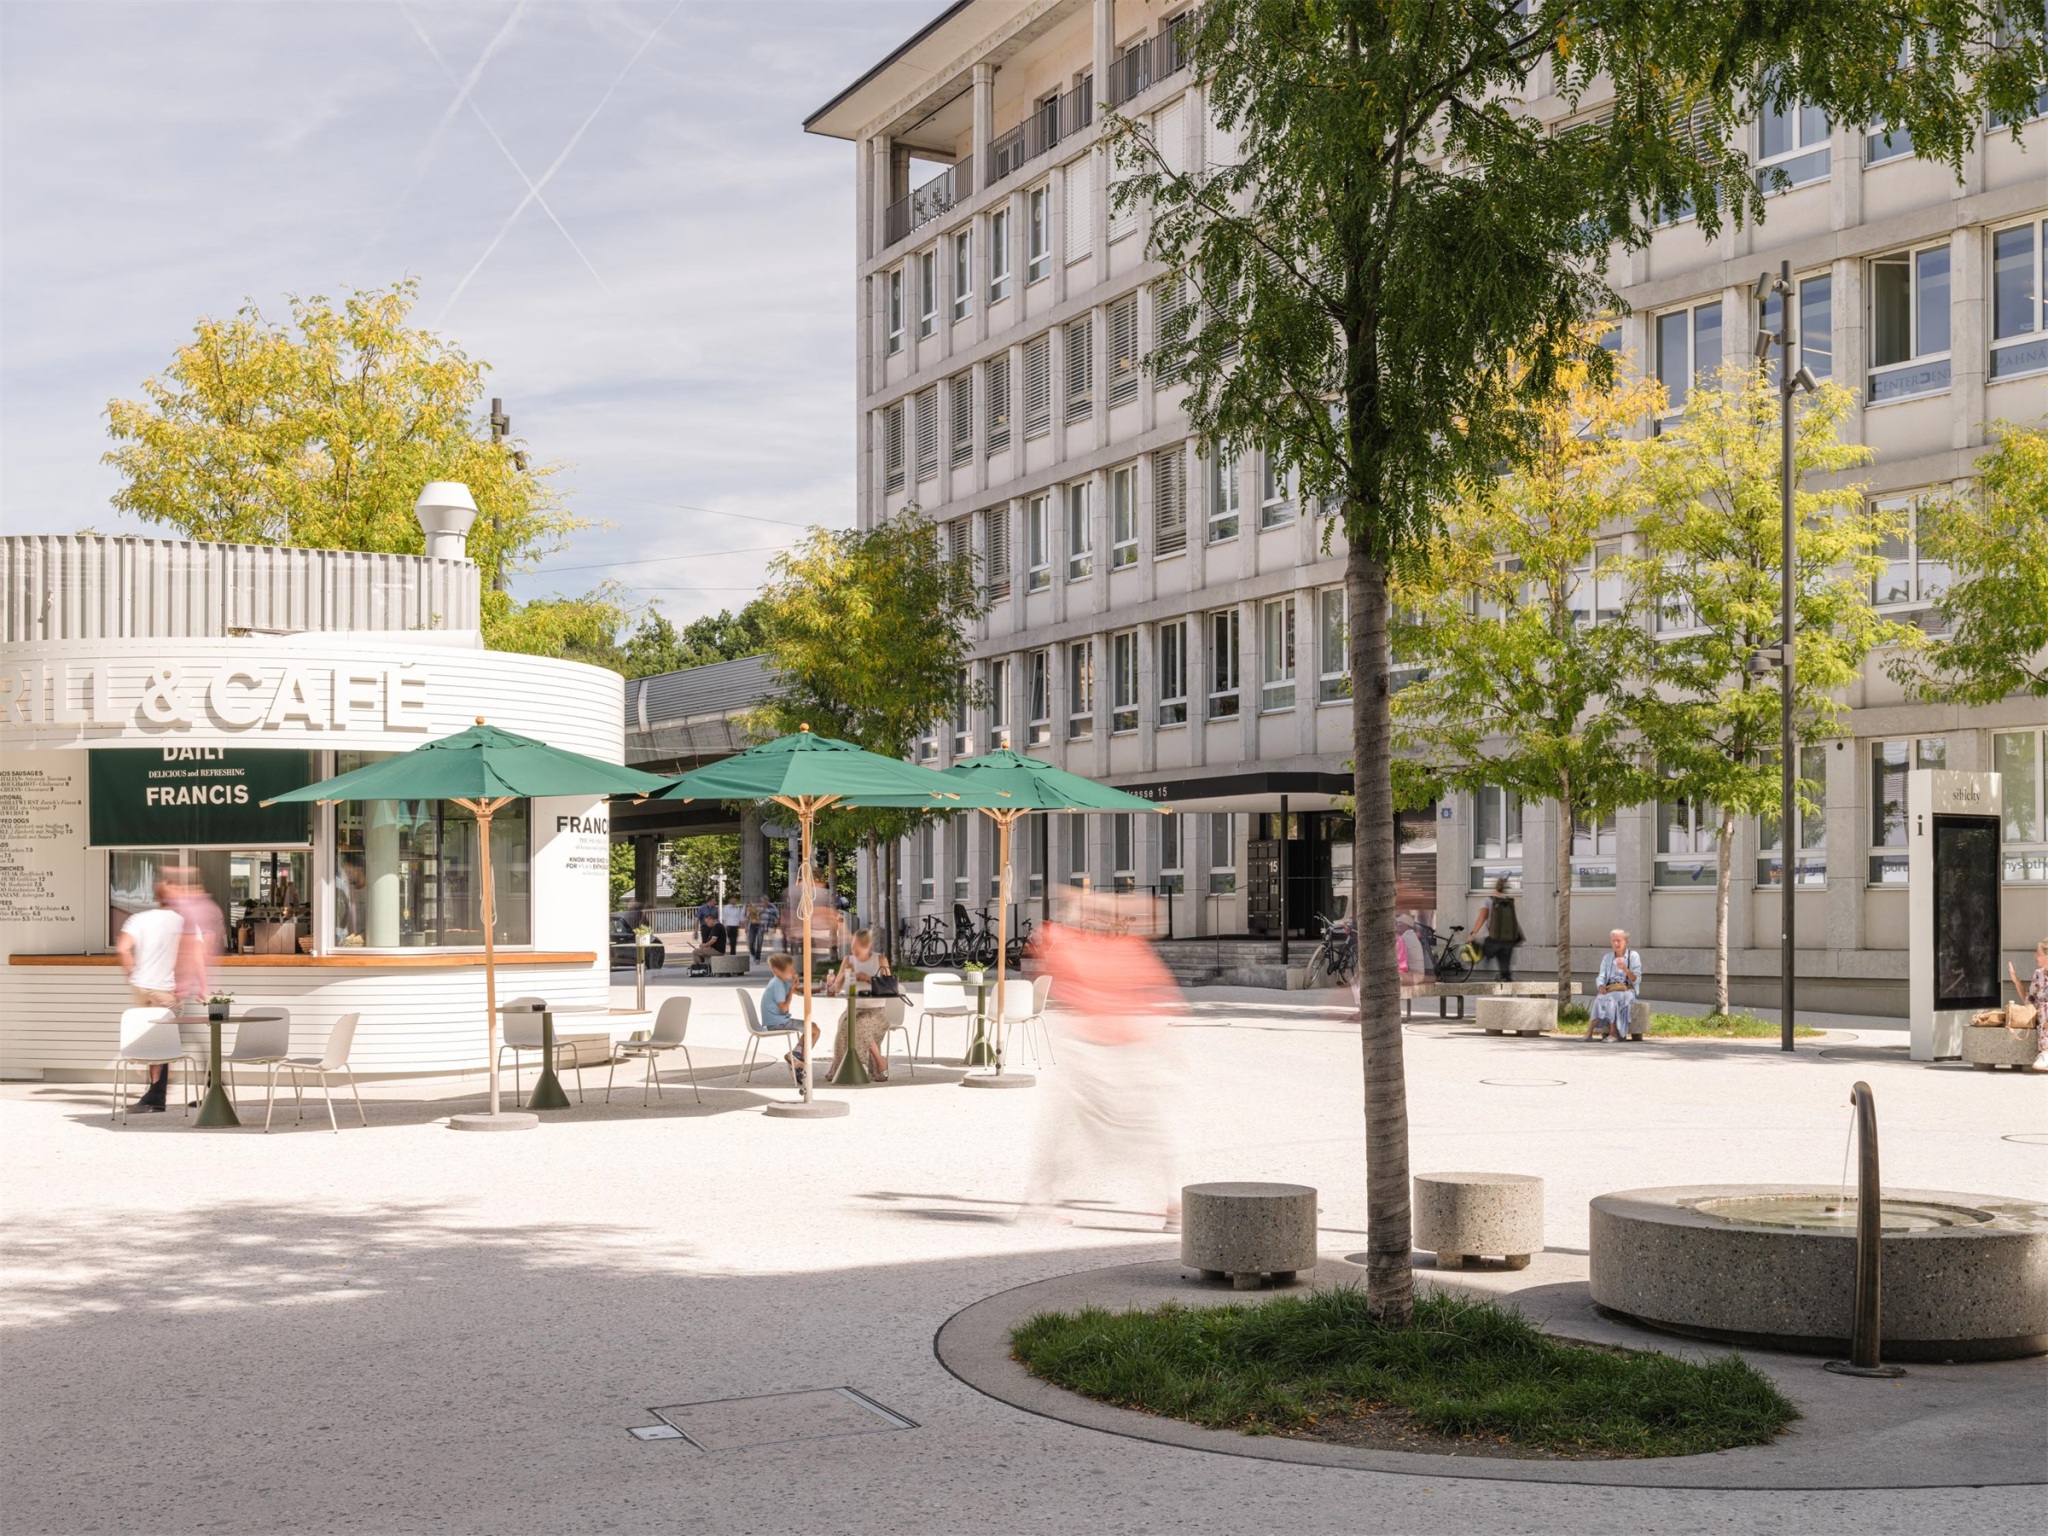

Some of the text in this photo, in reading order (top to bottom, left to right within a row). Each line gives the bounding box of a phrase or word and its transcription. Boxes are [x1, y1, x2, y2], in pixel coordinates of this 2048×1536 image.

[142, 661, 196, 724] &
[209, 661, 429, 730] CAFÉ
[163, 748, 225, 761] DAILY
[149, 770, 187, 778] DELICIOUS
[200, 768, 245, 776] REFRESHING
[146, 785, 249, 806] FRANCIS
[1158, 786, 1168, 797] 15
[556, 816, 609, 835] FRANC
[1269, 861, 1278, 872] 15
